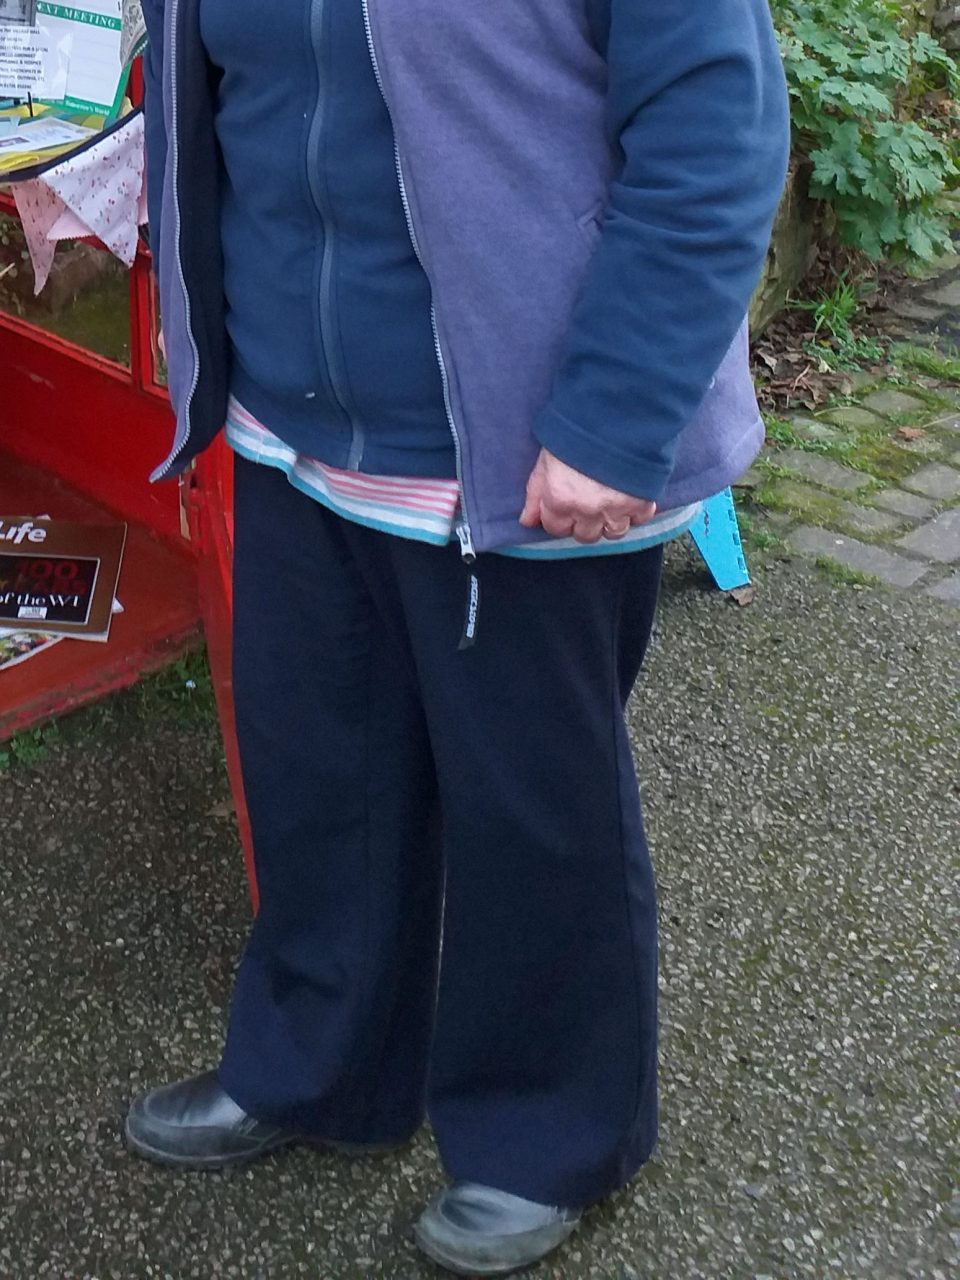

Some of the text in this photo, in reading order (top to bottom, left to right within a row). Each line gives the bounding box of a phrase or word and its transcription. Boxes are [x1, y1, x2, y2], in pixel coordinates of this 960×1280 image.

[63, 8, 115, 28] MEETING
[17, 593, 46, 606] the
[50, 594, 78, 607] WI
